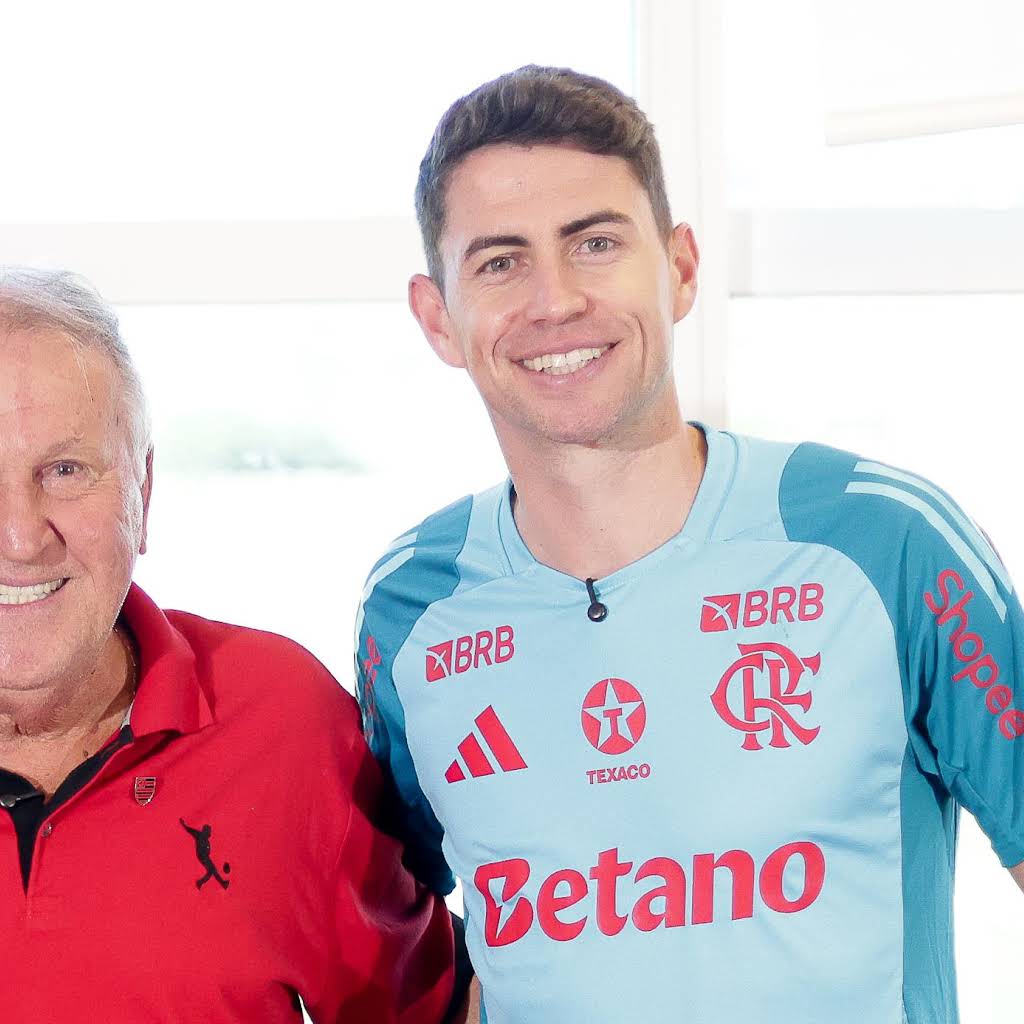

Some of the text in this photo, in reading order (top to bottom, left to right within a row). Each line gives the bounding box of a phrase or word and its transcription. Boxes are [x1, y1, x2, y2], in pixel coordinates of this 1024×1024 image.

[742, 583, 824, 628] BRB
[454, 625, 515, 674] BRB
[924, 568, 1024, 741] Shopee
[585, 763, 651, 785] TEXACO
[473, 841, 826, 947] Betano
